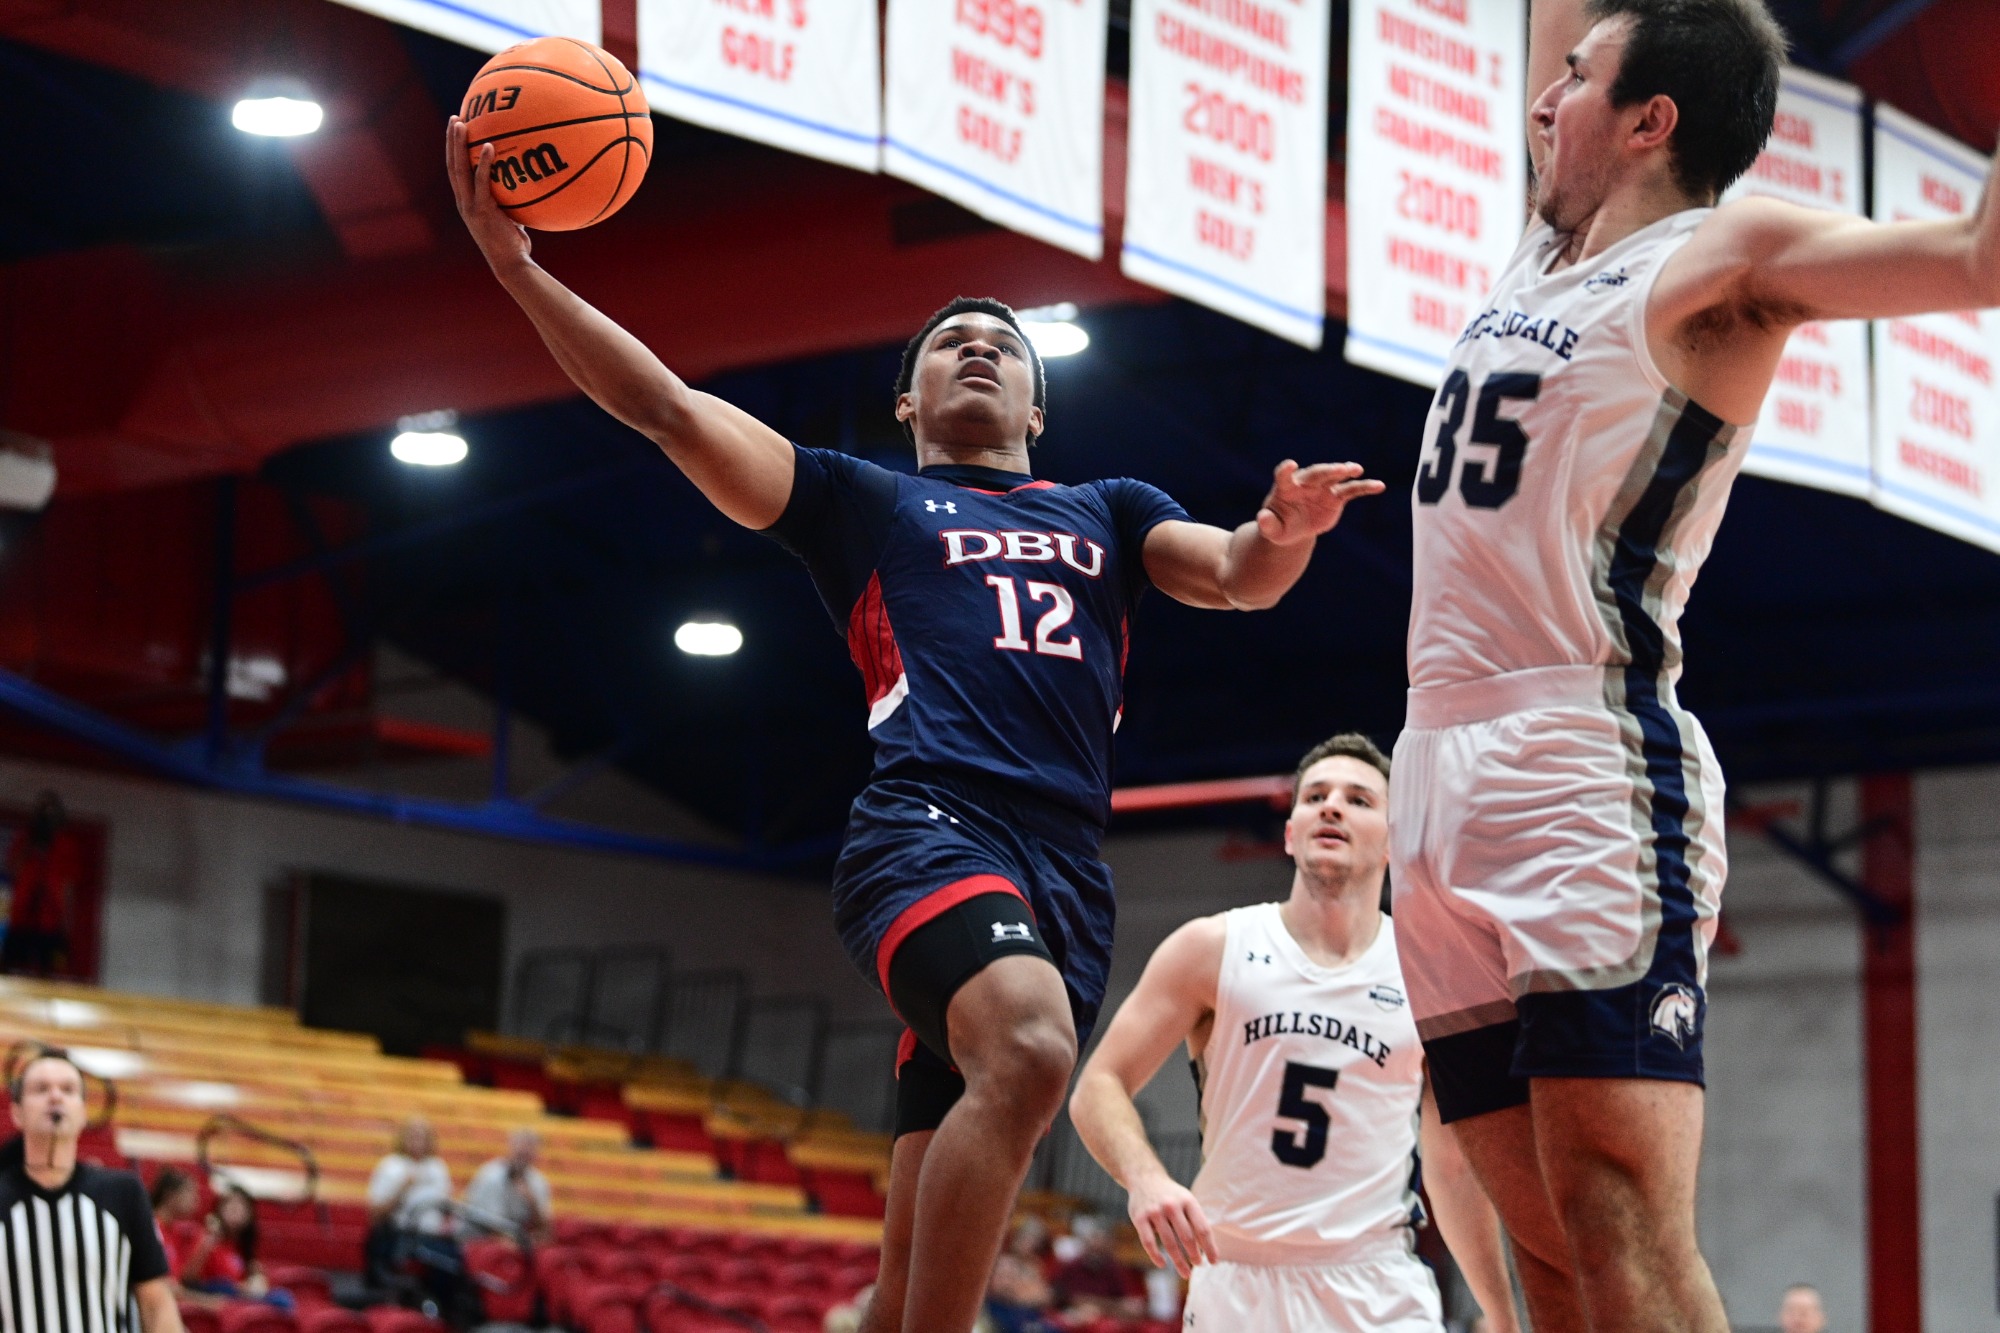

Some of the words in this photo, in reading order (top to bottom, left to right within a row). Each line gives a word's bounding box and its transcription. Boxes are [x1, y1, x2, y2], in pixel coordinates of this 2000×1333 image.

[721, 25, 796, 83] GOLF
[952, 48, 1036, 117] MEN'S
[1156, 11, 1306, 105] CHAMPIONS
[958, 105, 1023, 164] GOLF
[1183, 82, 1275, 163] 2000
[1189, 154, 1265, 215] MEN'S
[1396, 169, 1480, 240] 2000
[1195, 209, 1255, 261] GOLF
[1418, 368, 1543, 511] 35
[939, 527, 1105, 580] DBU
[985, 573, 1083, 662] 12
[1244, 1011, 1391, 1070] HILLSDALE
[1271, 1058, 1340, 1170] 5
